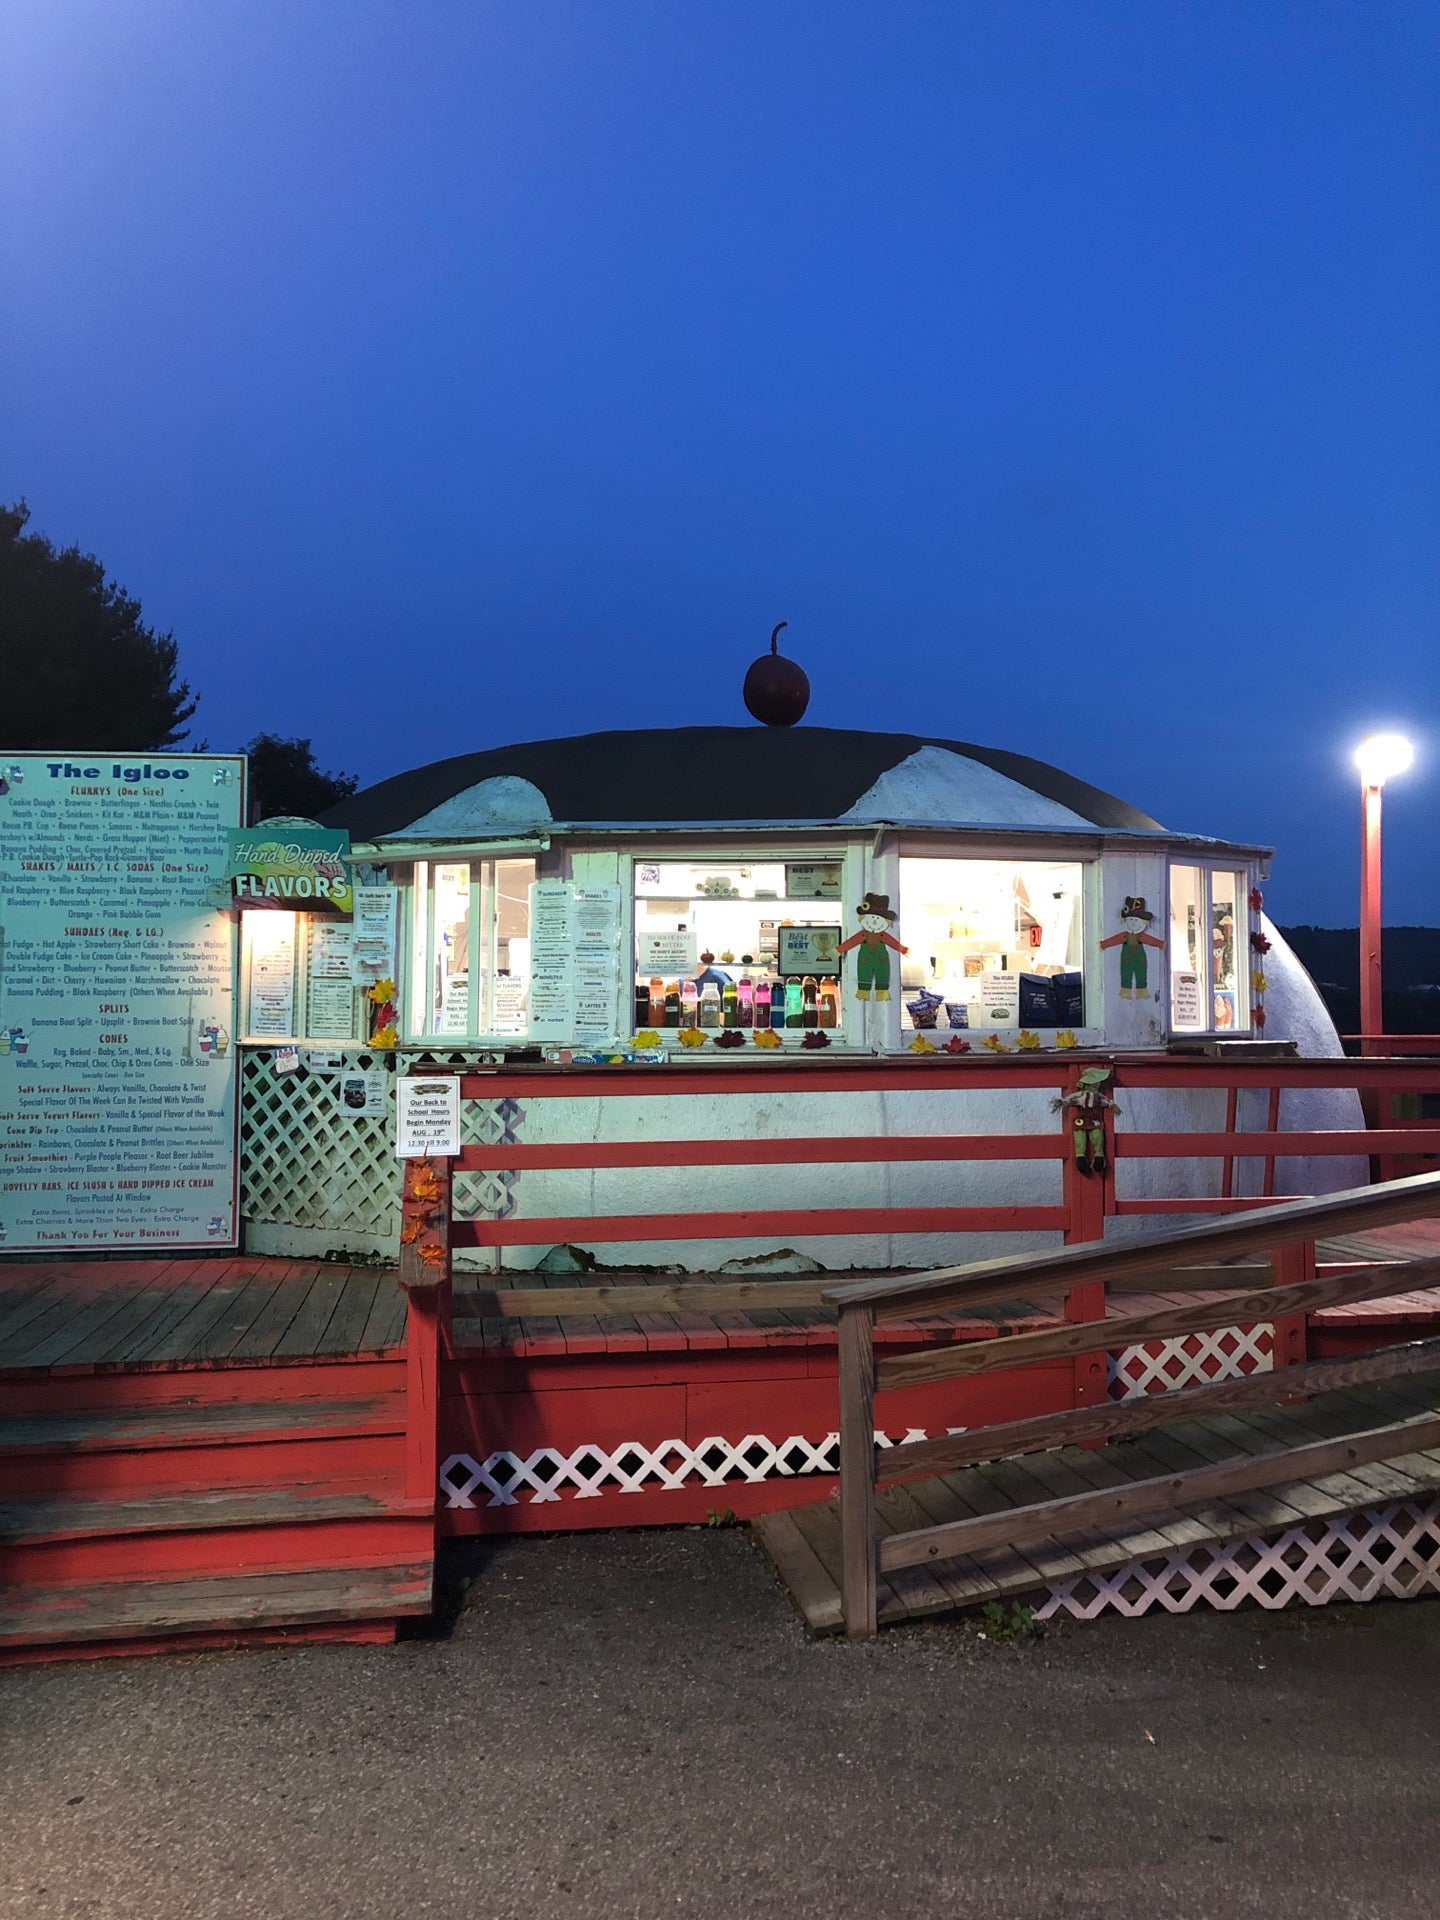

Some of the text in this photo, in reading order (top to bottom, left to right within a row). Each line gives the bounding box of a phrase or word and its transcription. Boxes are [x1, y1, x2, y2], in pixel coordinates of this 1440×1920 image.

[46, 764, 190, 782] The Igloo
[118, 787, 138, 797] (One
[142, 788, 164, 796] Size)
[9, 798, 140, 809] Cookie Dough Butterfinger
[66, 810, 92, 818] Snickers
[108, 822, 132, 830] Smores
[103, 834, 216, 844] Grass Hopper Peppermint
[29, 844, 136, 854] Pudding Covered Pretzel
[235, 843, 345, 870] Hand Dipped
[22, 862, 209, 872] SHAKES MALTS SODAS (One Size)
[80, 874, 118, 884] Strawberry
[16, 886, 172, 896] Raspberry Raspberry Raspberry
[236, 875, 347, 898] FLAVORS
[137, 899, 170, 908] Pineapple
[68, 910, 143, 920] Orange Pink Bubble
[64, 927, 104, 937] SUNDAES
[13, 940, 140, 950] Fudge Apple Strawberry Short
[33, 952, 218, 962] Fudge Cream Pineapple Strawberry
[130, 964, 198, 972] Butter Butterscotch
[4, 976, 220, 986] Caramel Dirt Cherry Hawaiian Marshmallow Chocolate
[8, 988, 176, 998] Banana Pudding Black Raspberry When
[99, 1004, 130, 1014] SPLITS
[32, 1017, 194, 1028] Banana Boat Split Brownie Boat Split
[99, 1034, 128, 1044] CONES
[70, 1048, 91, 1056] Baked
[112, 1060, 126, 1070] Chip
[136, 1060, 152, 1068] Oreo
[180, 1059, 194, 1067] One
[196, 1059, 210, 1067] Size
[97, 1085, 120, 1094] Always
[122, 1084, 146, 1093] Vanilla,
[150, 1084, 180, 1092] Chocolate
[19, 1098, 43, 1108] Special
[46, 1098, 66, 1106] Flavor
[78, 1097, 90, 1105] The
[92, 1097, 110, 1105] Week
[113, 1096, 126, 1104] Can
[138, 1096, 162, 1104] Twisted
[164, 1096, 180, 1104] With
[18, 1112, 40, 1120] Serve
[43, 1112, 70, 1121] Yogurt
[106, 1111, 129, 1119] Vanilla
[138, 1110, 162, 1120] Special
[164, 1110, 184, 1118] Flavor
[208, 1109, 224, 1117] Week
[66, 1125, 98, 1134] Chocolate
[74, 1138, 165, 1148] Chocolate Peanut Brittles
[28, 1150, 214, 1162] Smoothies Purple People Pleaser Root Beer Jubilee
[50, 1162, 227, 1175] Strawberry Blaster Blueberry Blaster Cookie Monster
[3, 1182, 38, 1192] NOVELTY
[83, 1181, 106, 1190] SLUSH
[118, 1181, 138, 1190] HAND
[142, 1180, 170, 1188] DIPPED
[173, 1180, 185, 1188] ICE
[66, 1193, 151, 1203] Flavors Posted Window
[174, 1216, 200, 1224] Charge
[37, 1228, 180, 1240] Thank You For Your Business
